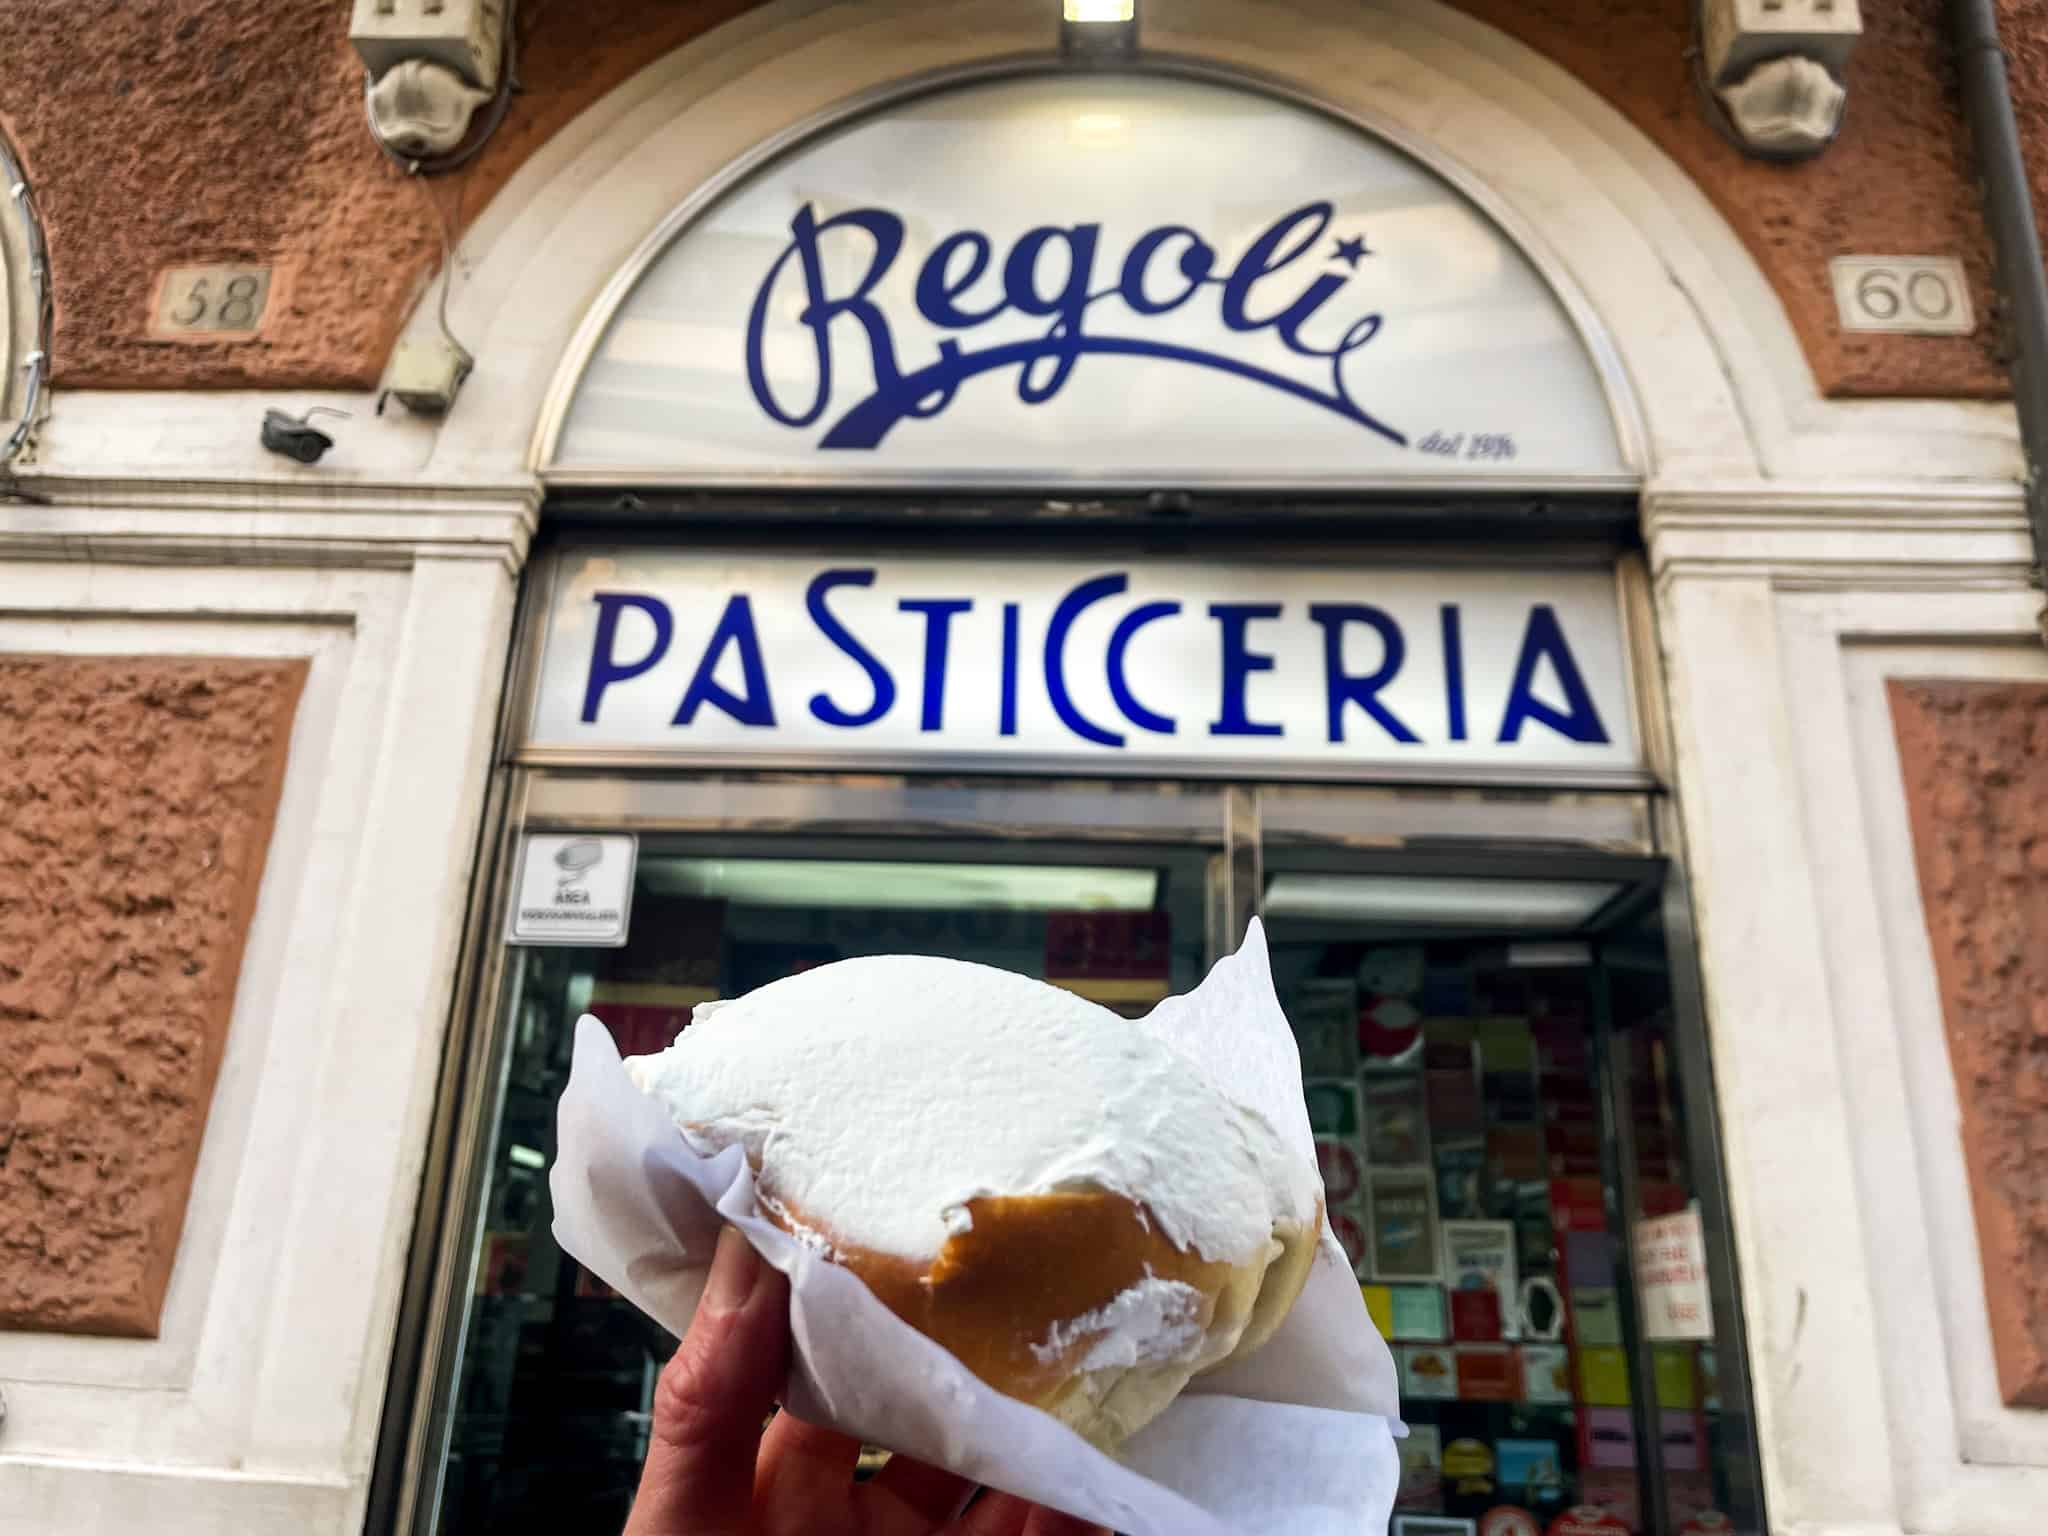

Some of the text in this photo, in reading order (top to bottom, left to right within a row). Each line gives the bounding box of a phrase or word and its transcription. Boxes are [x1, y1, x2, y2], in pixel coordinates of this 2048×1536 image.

[170, 275, 258, 328] 58
[747, 201, 1407, 450] Regoli
[1856, 268, 1953, 320] 60
[580, 567, 1612, 749] PASTICCERIA
